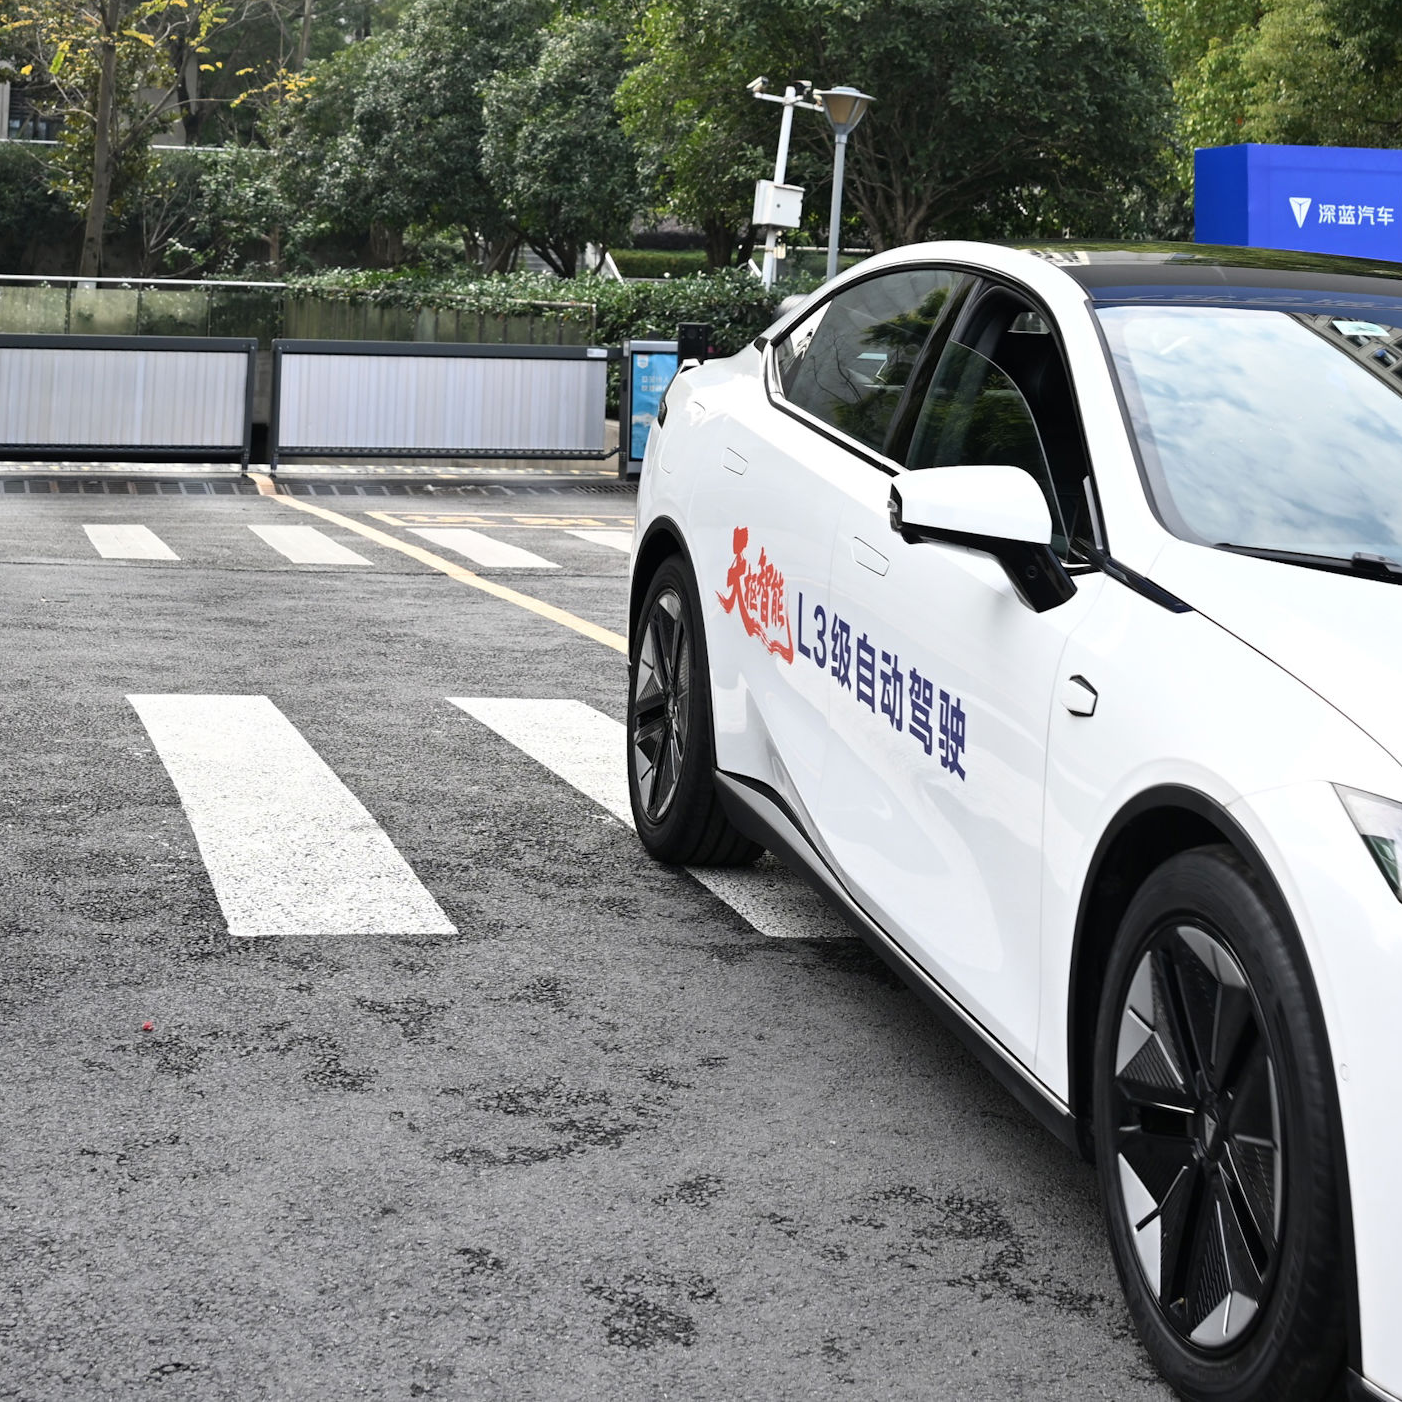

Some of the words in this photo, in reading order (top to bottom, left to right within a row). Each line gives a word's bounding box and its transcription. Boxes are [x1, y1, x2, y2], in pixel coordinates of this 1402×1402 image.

[1318, 203, 1395, 226] 深蓝汽车
[798, 591, 966, 782] L3级自动驾驶
